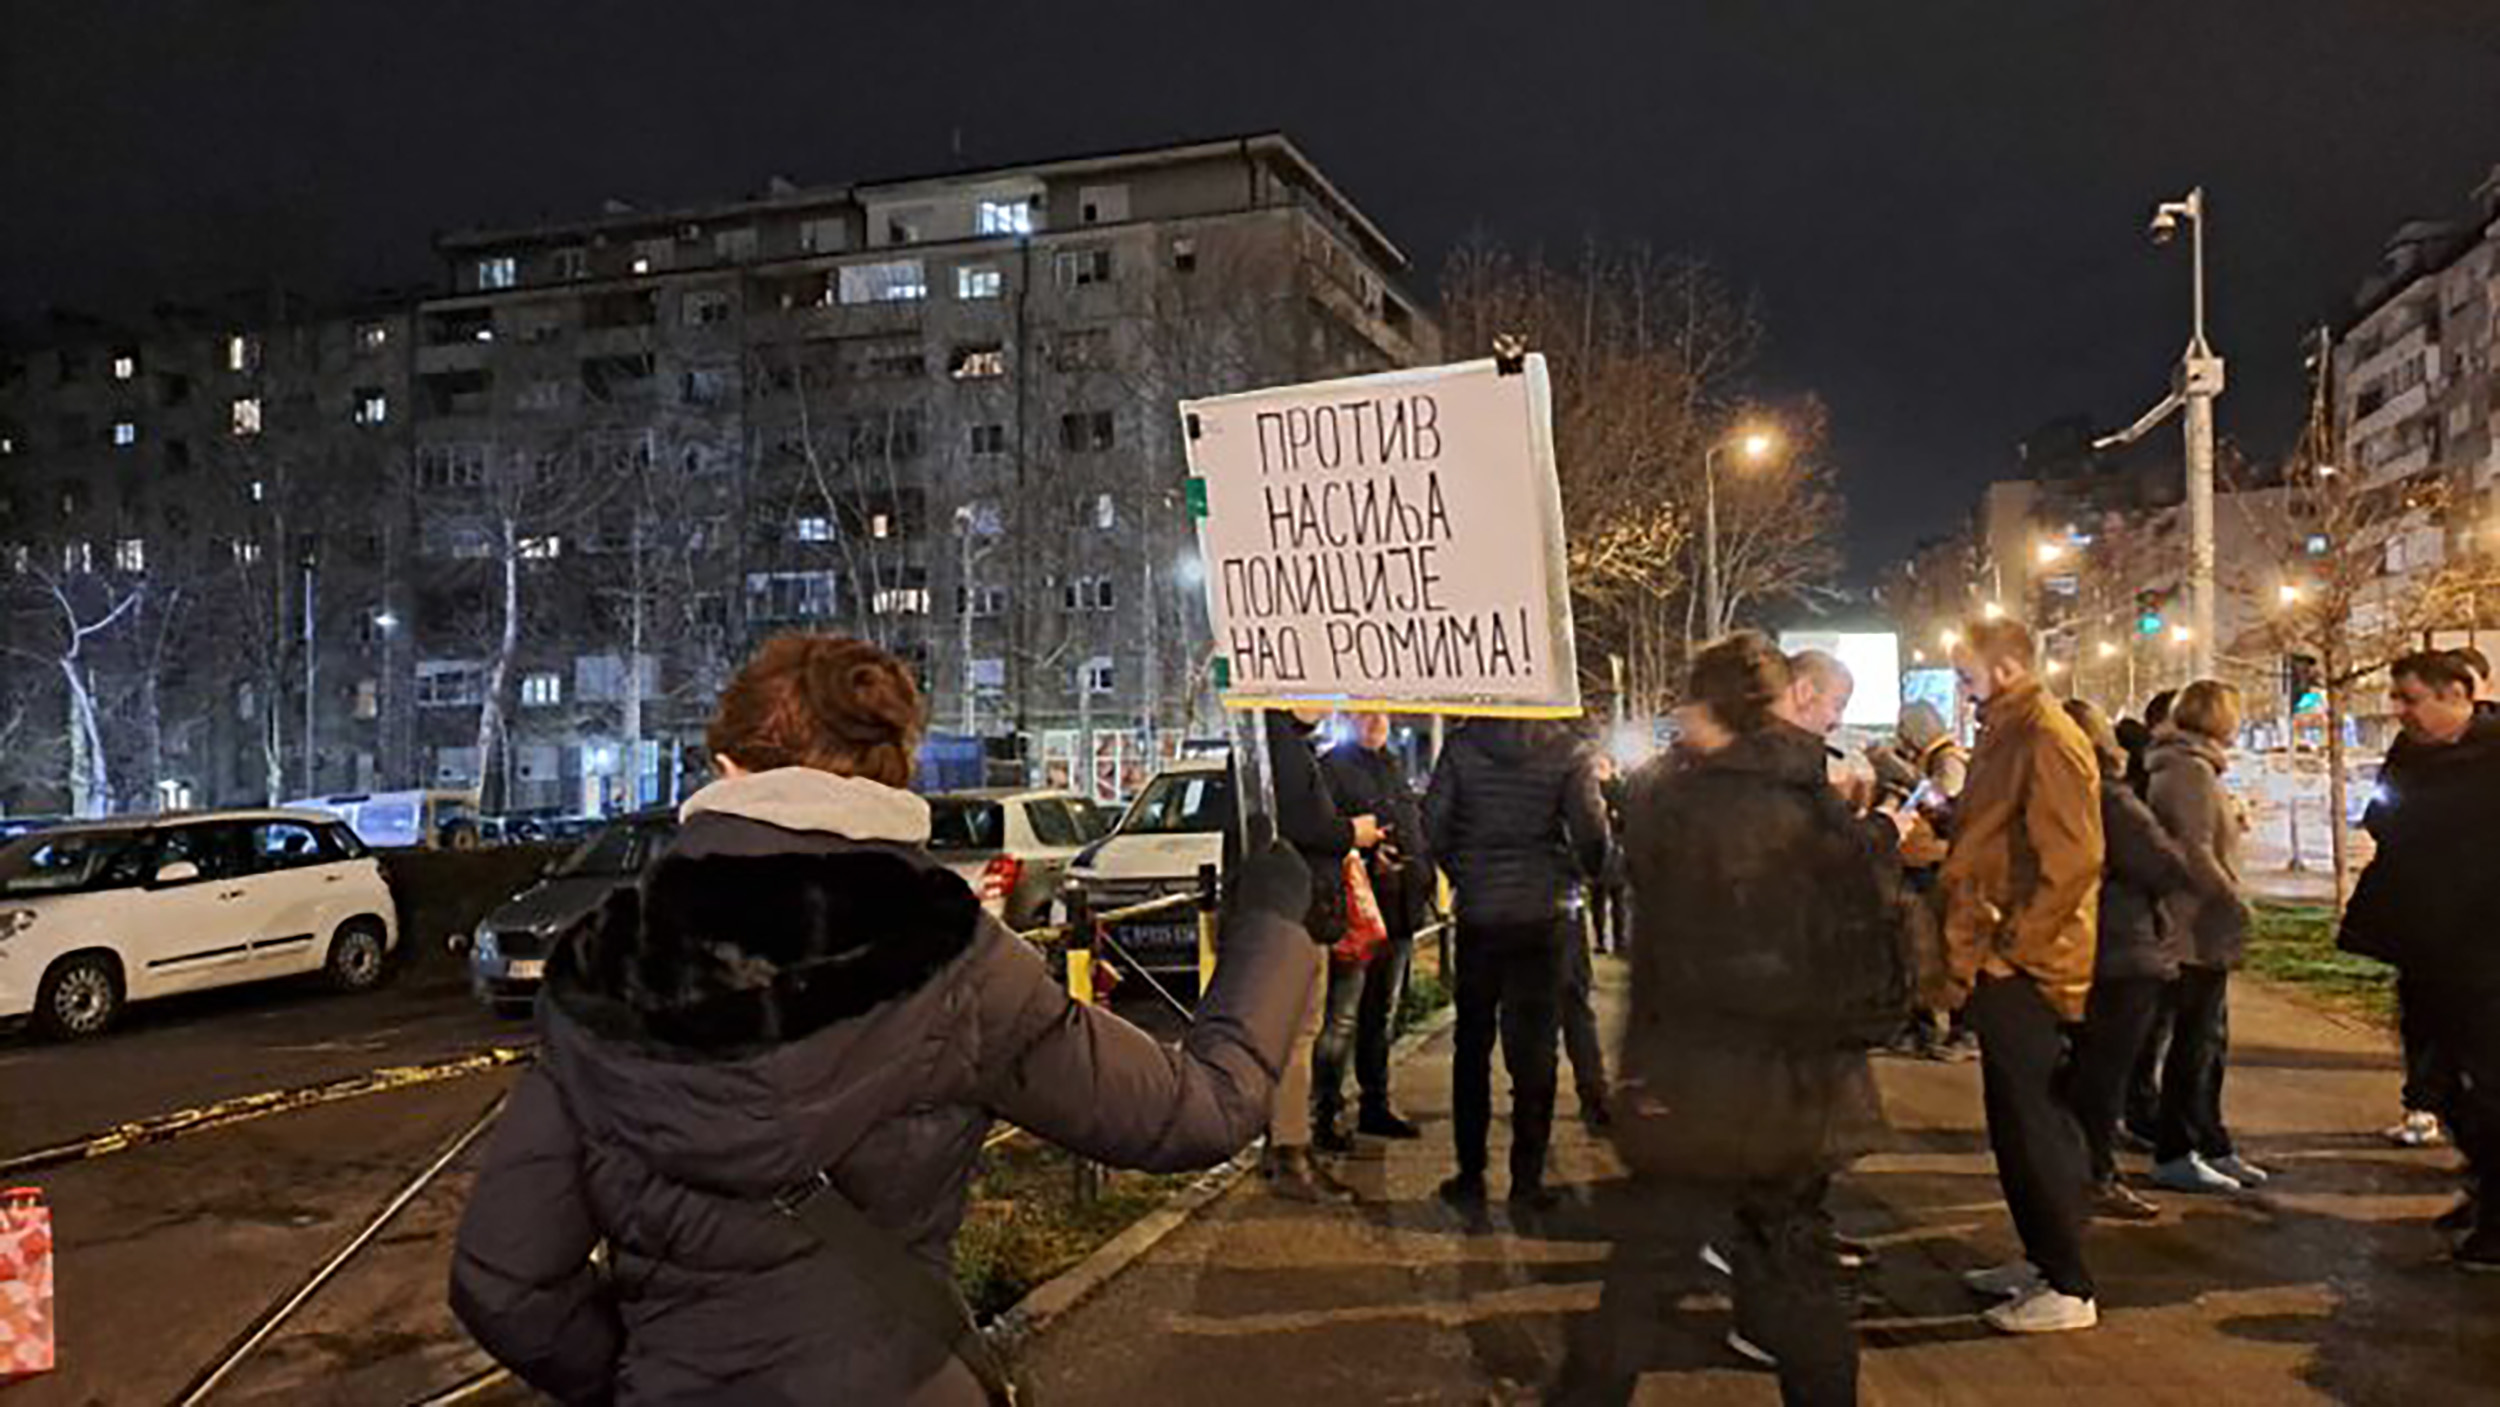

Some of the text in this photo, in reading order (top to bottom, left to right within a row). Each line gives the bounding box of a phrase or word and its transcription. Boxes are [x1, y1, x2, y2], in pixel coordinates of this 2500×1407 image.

[1257, 395, 1441, 474] ПРОТИВ
[1265, 472, 1451, 549] НАСИЉА
[1223, 547, 1447, 617] ПОЛИЦИЈЕ
[1229, 608, 1532, 681] НАД РОМИМА!
